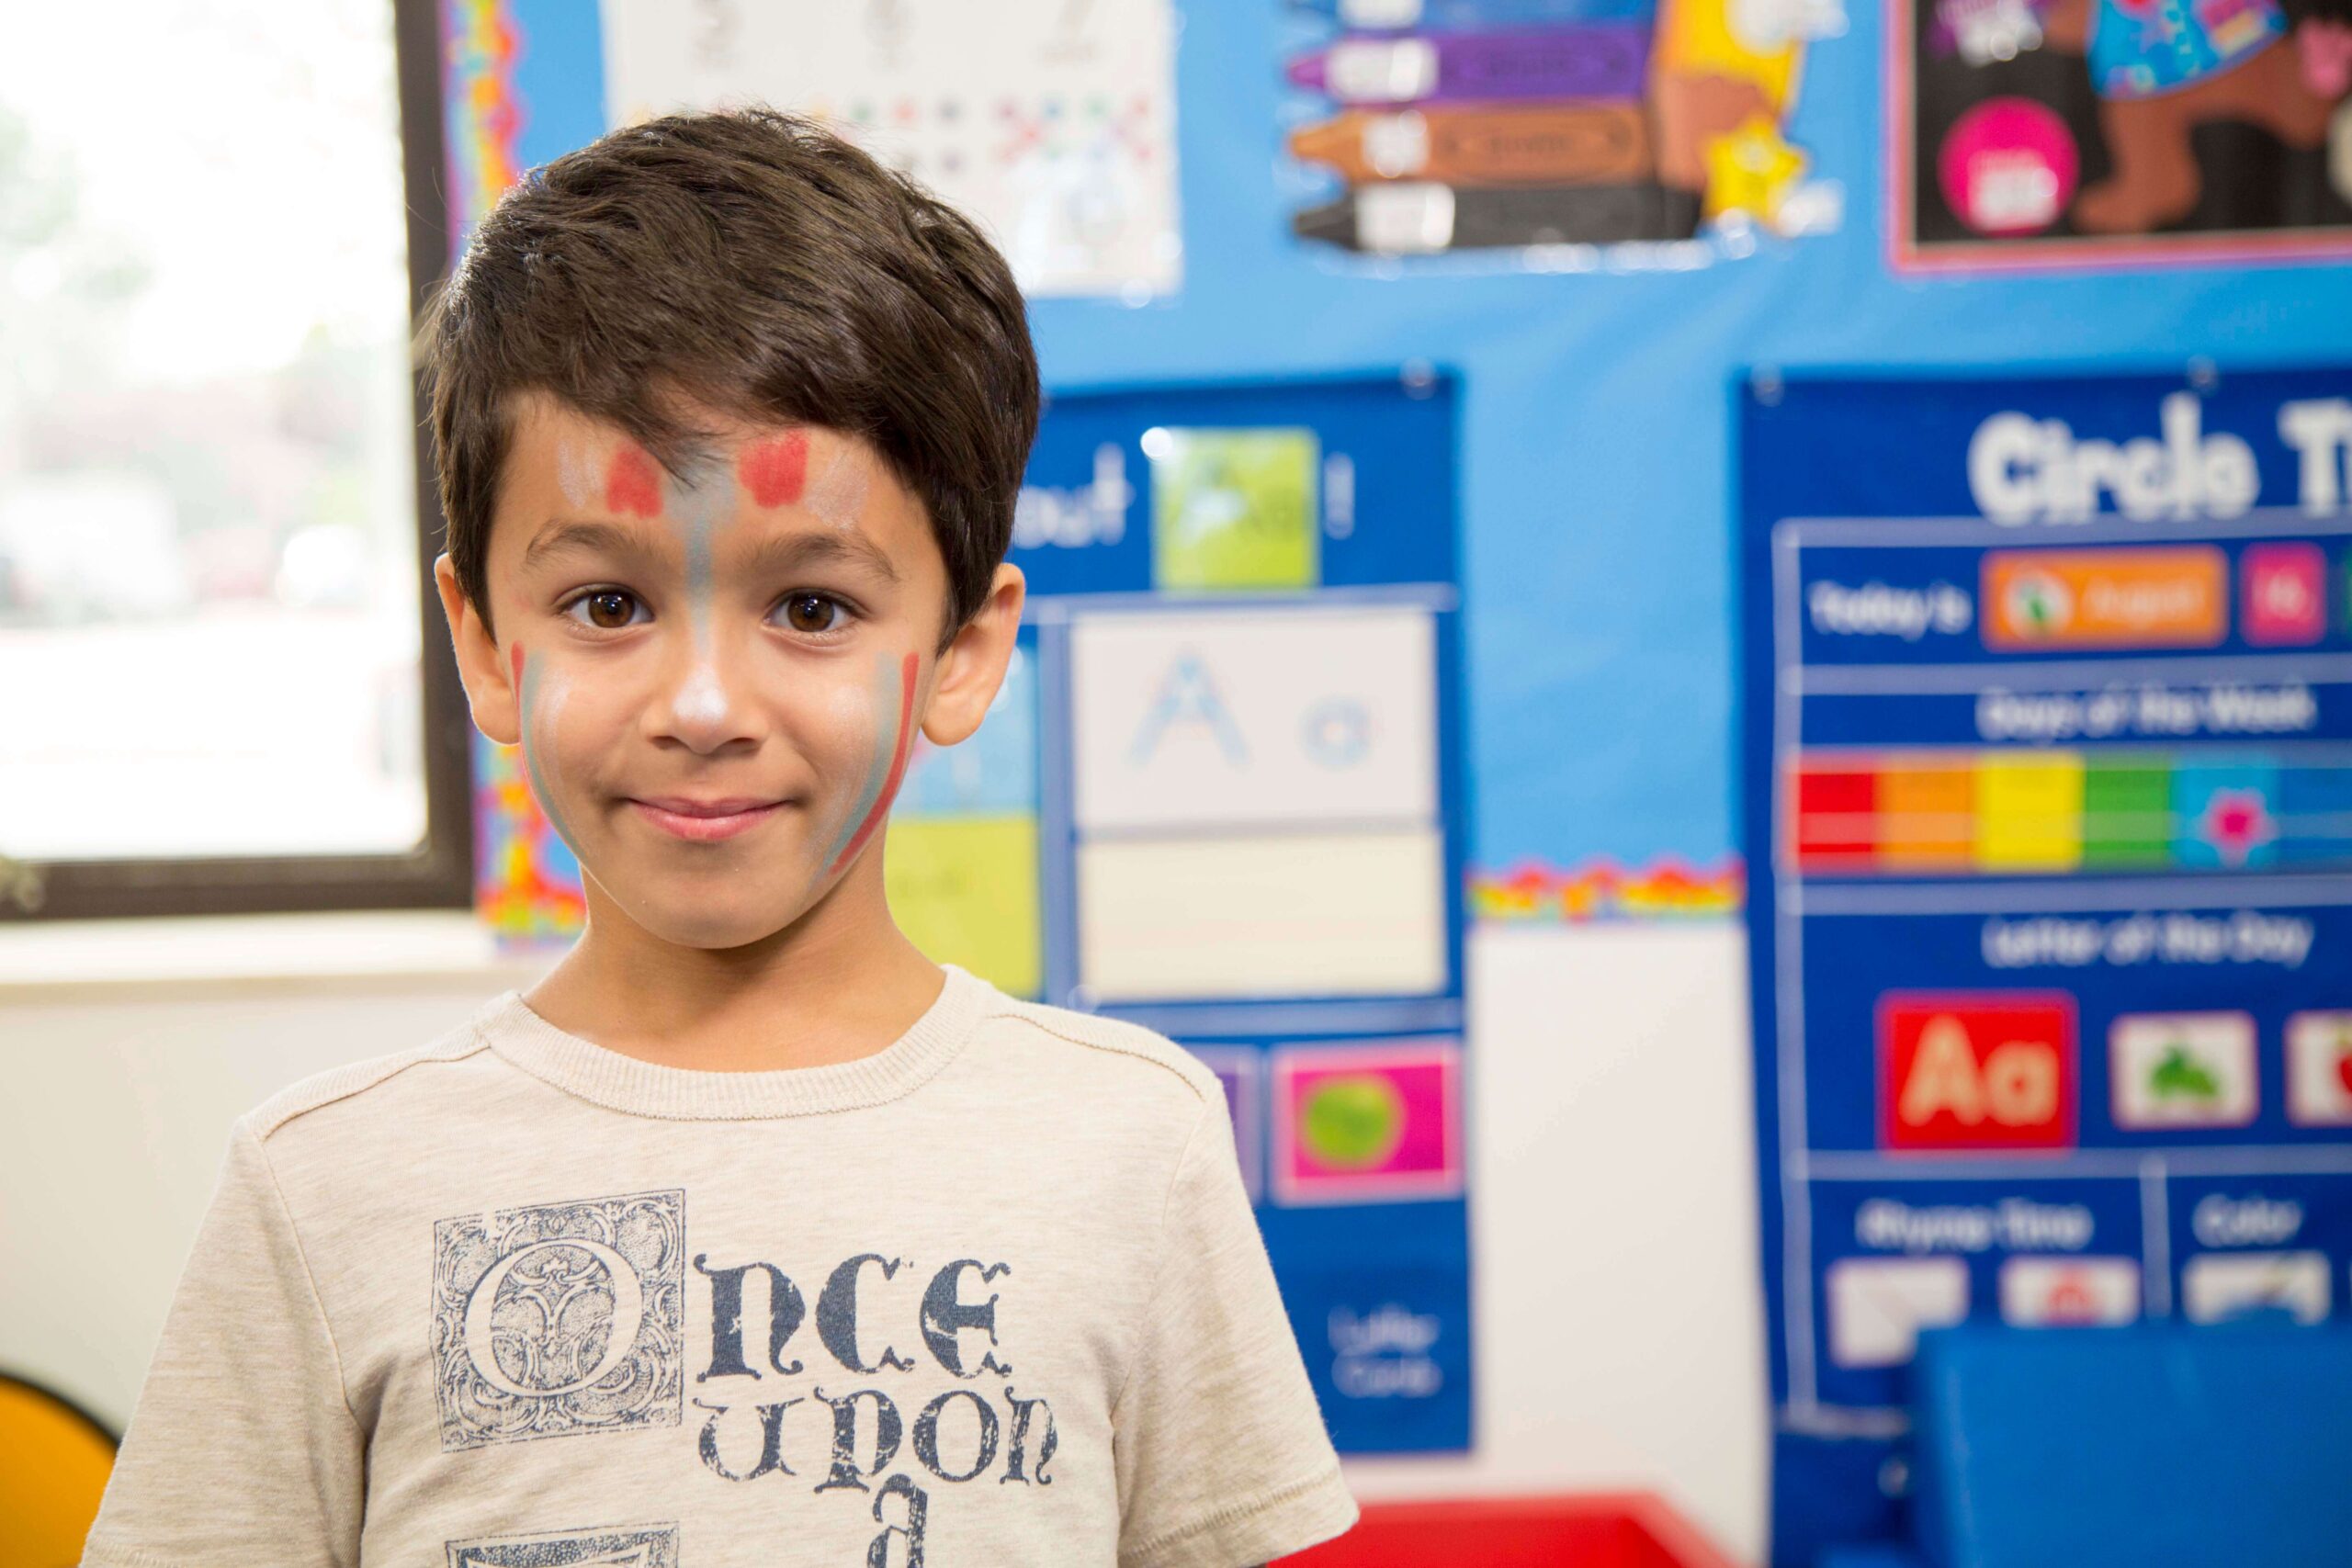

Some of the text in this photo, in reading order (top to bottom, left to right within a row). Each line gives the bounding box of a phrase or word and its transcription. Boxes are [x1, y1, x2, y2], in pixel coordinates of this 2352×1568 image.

[1967, 393, 2260, 527] Circle
[1811, 582, 1928, 637] Today
[2199, 678, 2314, 731] Week
[1983, 910, 2313, 967] Letter of the Day
[1898, 1013, 2061, 1128] Aa
[2193, 1194, 2302, 1247] Color
